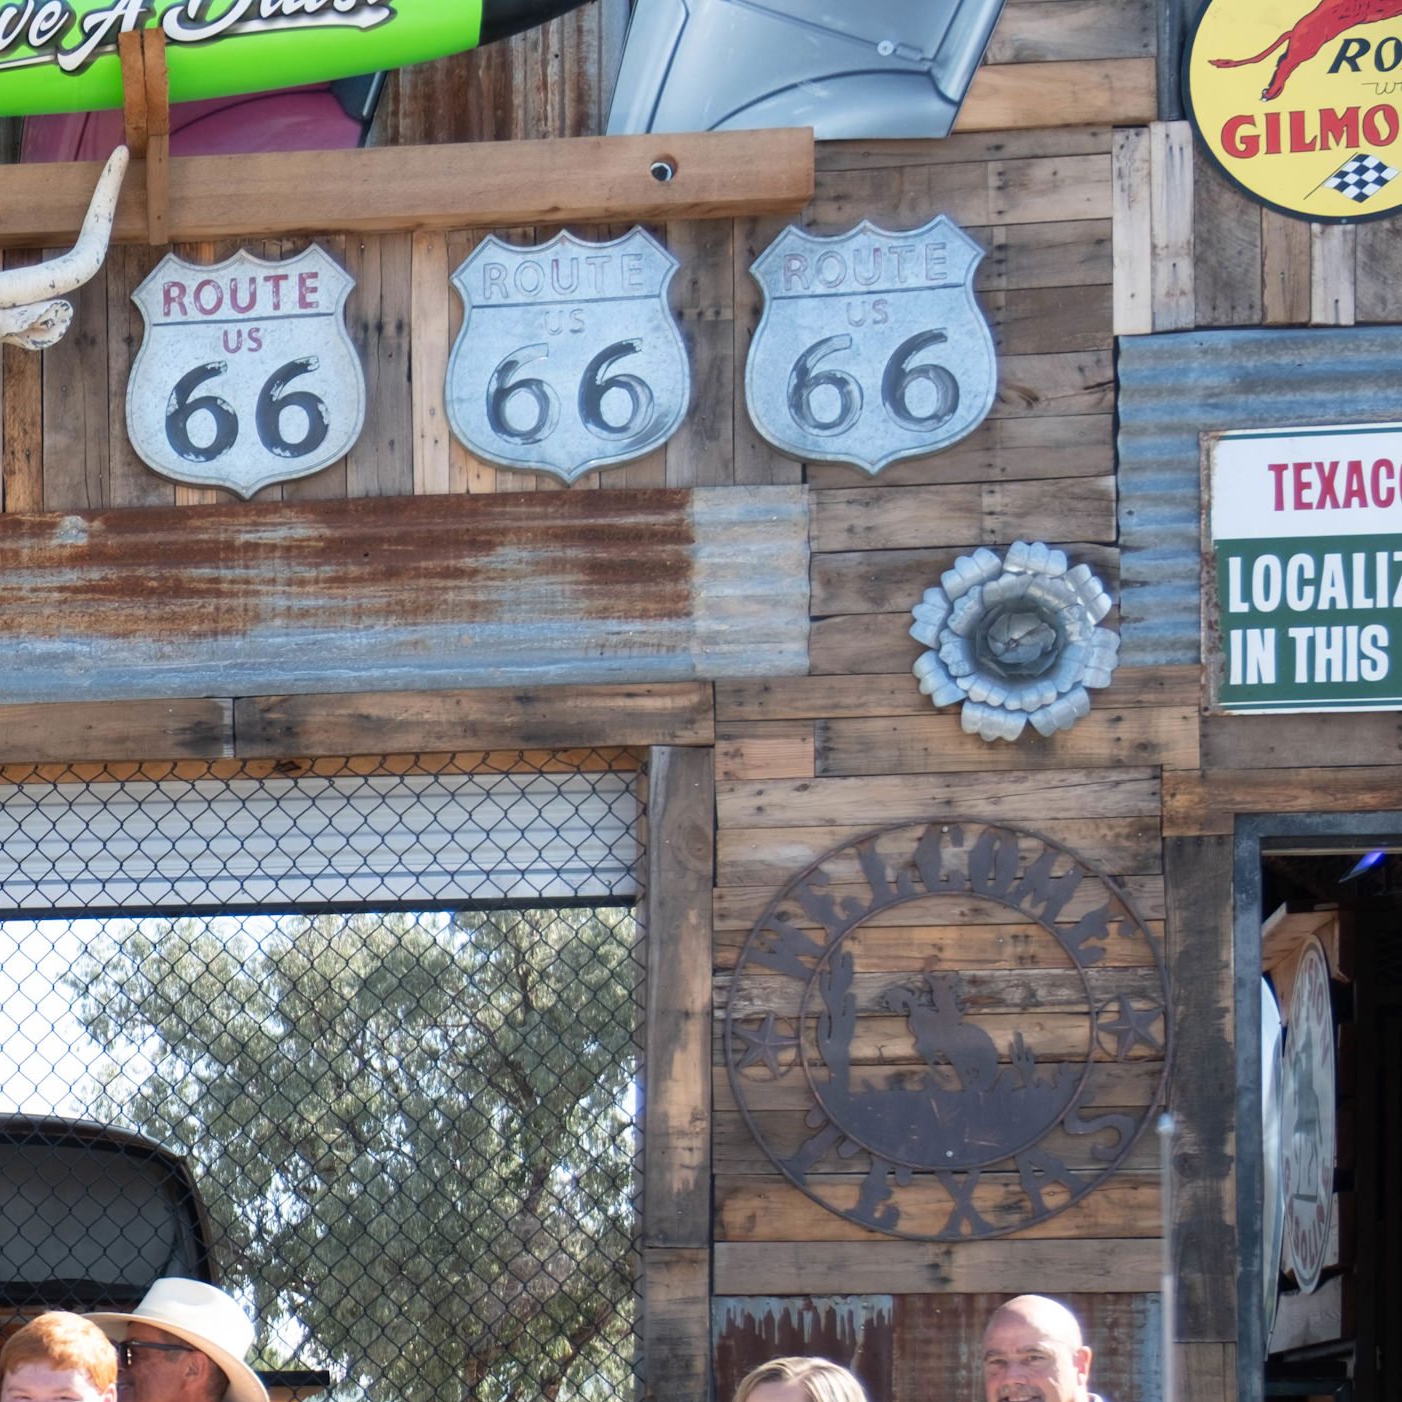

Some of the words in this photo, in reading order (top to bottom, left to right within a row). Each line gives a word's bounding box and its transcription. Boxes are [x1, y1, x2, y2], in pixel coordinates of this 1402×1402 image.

[482, 253, 644, 300] ROUTE
[782, 241, 948, 291] ROUTE
[162, 271, 319, 318] ROUTE
[846, 298, 889, 328] US
[222, 327, 263, 354] US
[544, 308, 586, 336] US
[164, 355, 330, 463] 66
[485, 336, 655, 446] 66
[786, 326, 961, 438] 66
[1267, 458, 1402, 512] TEXAC
[1229, 627, 1277, 686] IN
[1288, 623, 1390, 684] THIS
[744, 822, 1141, 984] WELCOME
[776, 1104, 1135, 1238] TEXAS
